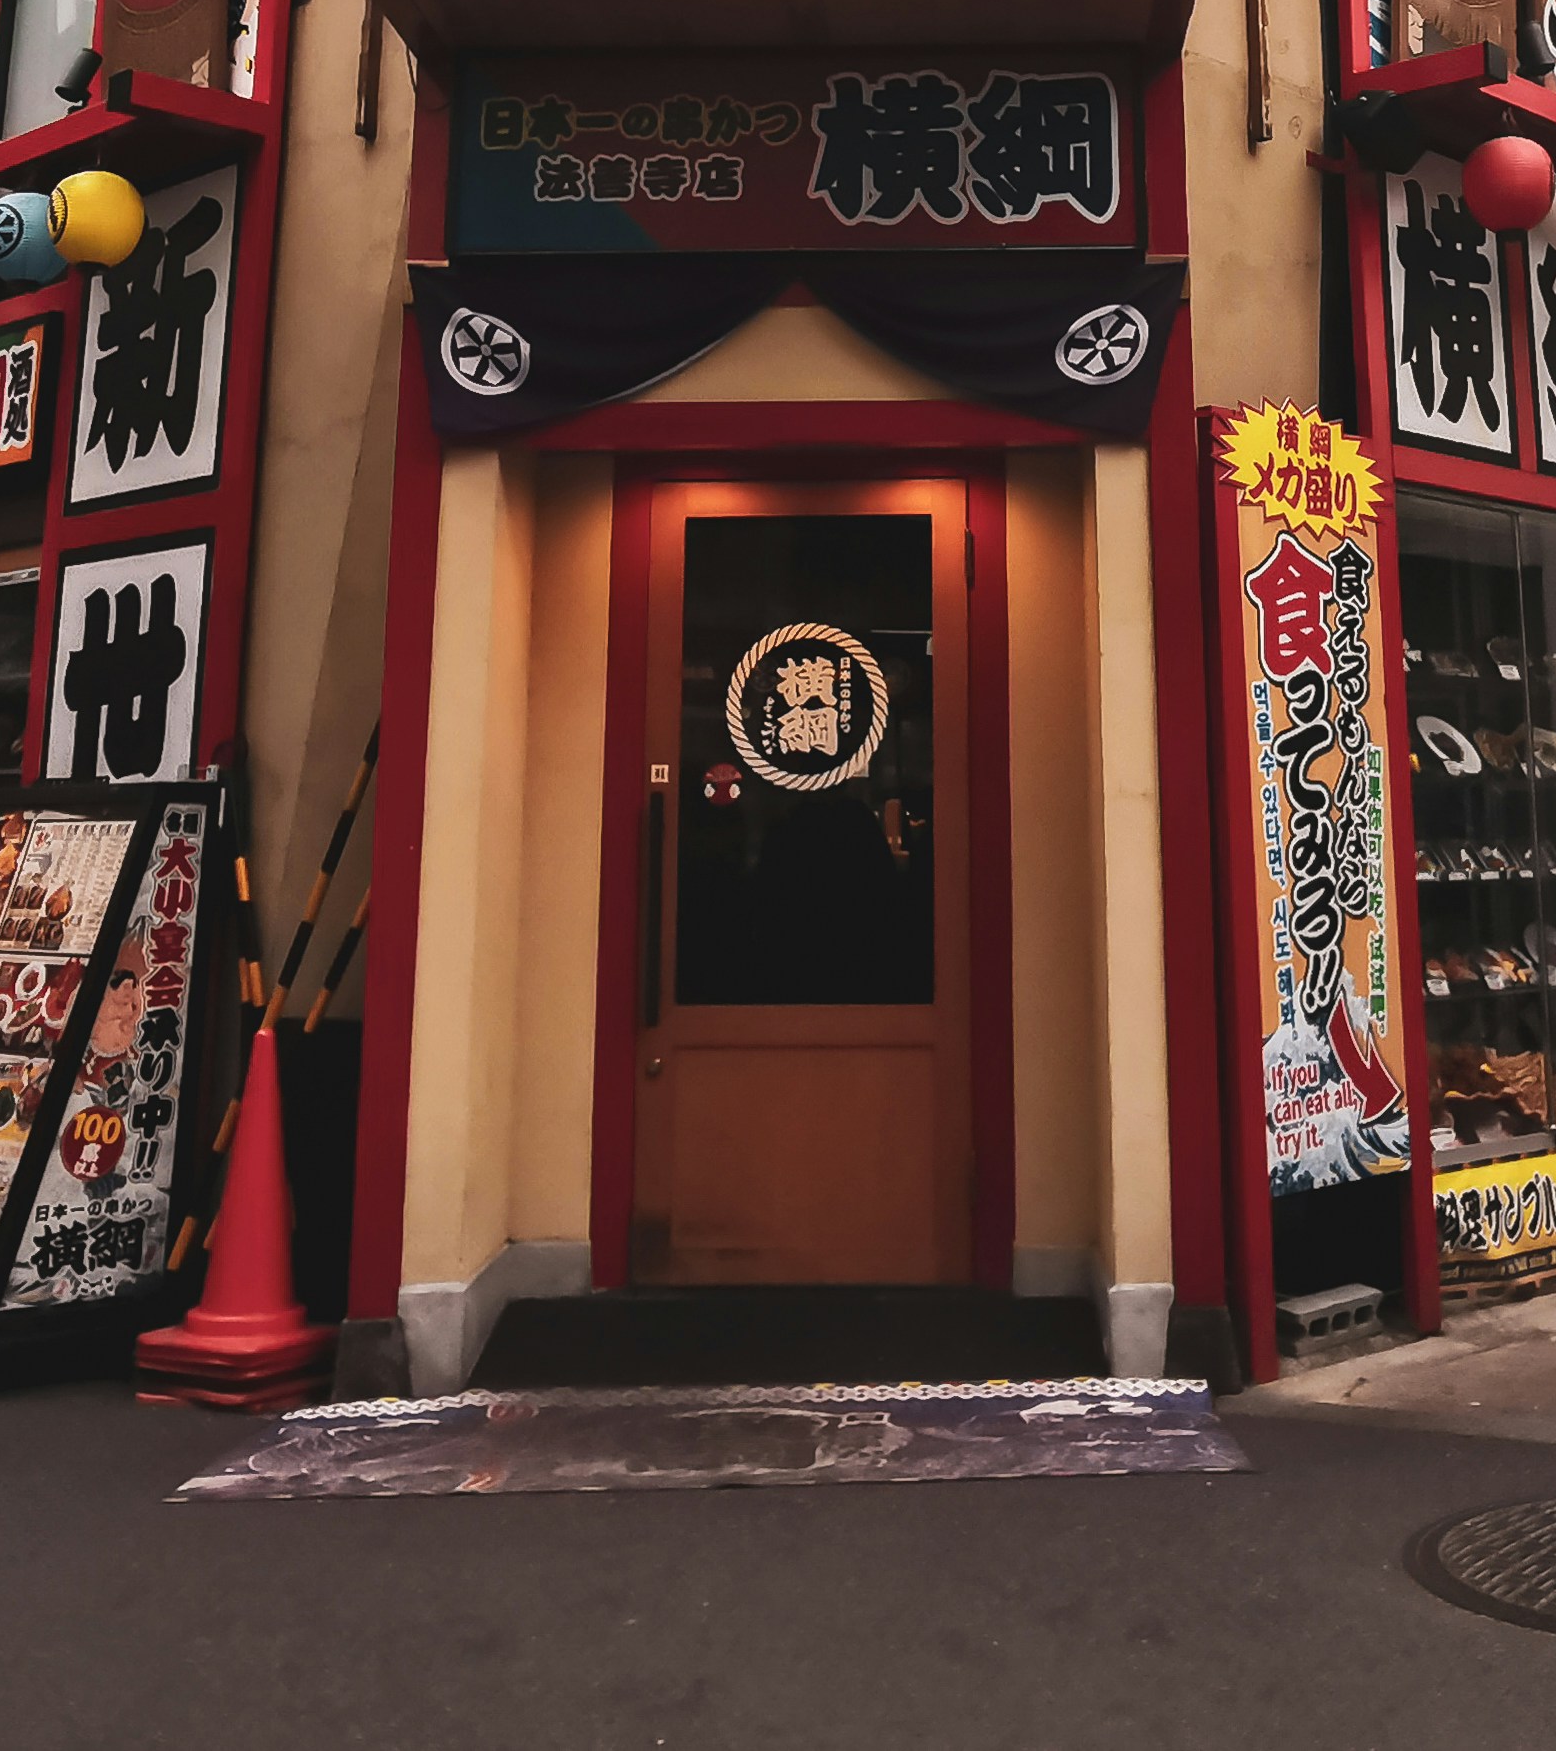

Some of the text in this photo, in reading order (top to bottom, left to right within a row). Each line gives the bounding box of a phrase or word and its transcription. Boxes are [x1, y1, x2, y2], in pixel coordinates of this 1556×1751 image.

[481, 95, 803, 149] 日本一の串かつ
[807, 69, 1121, 226] 横綱
[534, 153, 744, 202] 法善寺店
[90, 195, 223, 475] 新
[1396, 176, 1502, 434] 横
[6, 341, 38, 452] 酒処
[1277, 414, 1332, 463] 横綱
[1252, 452, 1358, 523] メガ盛り
[65, 572, 189, 782] 世
[776, 656, 838, 756] 横綱
[840, 657, 852, 734] 日本一の串かつ
[1253, 680, 1274, 743] 먹을
[1329, 538, 1375, 918] 食えるもんなら
[1246, 531, 1343, 1014] 食ってみろ!!
[1257, 750, 1277, 776] 수
[1272, 896, 1292, 961] 시도
[127, 837, 199, 1185] 大小宴会承り中!!
[1271, 1065, 1319, 1095] If you
[1273, 1083, 1360, 1126] can eat all,
[73, 1112, 122, 1145] 100
[1275, 1126, 1325, 1162] try it.
[35, 1198, 153, 1223] 日本一の串かつ
[31, 1217, 146, 1277] 横綱
